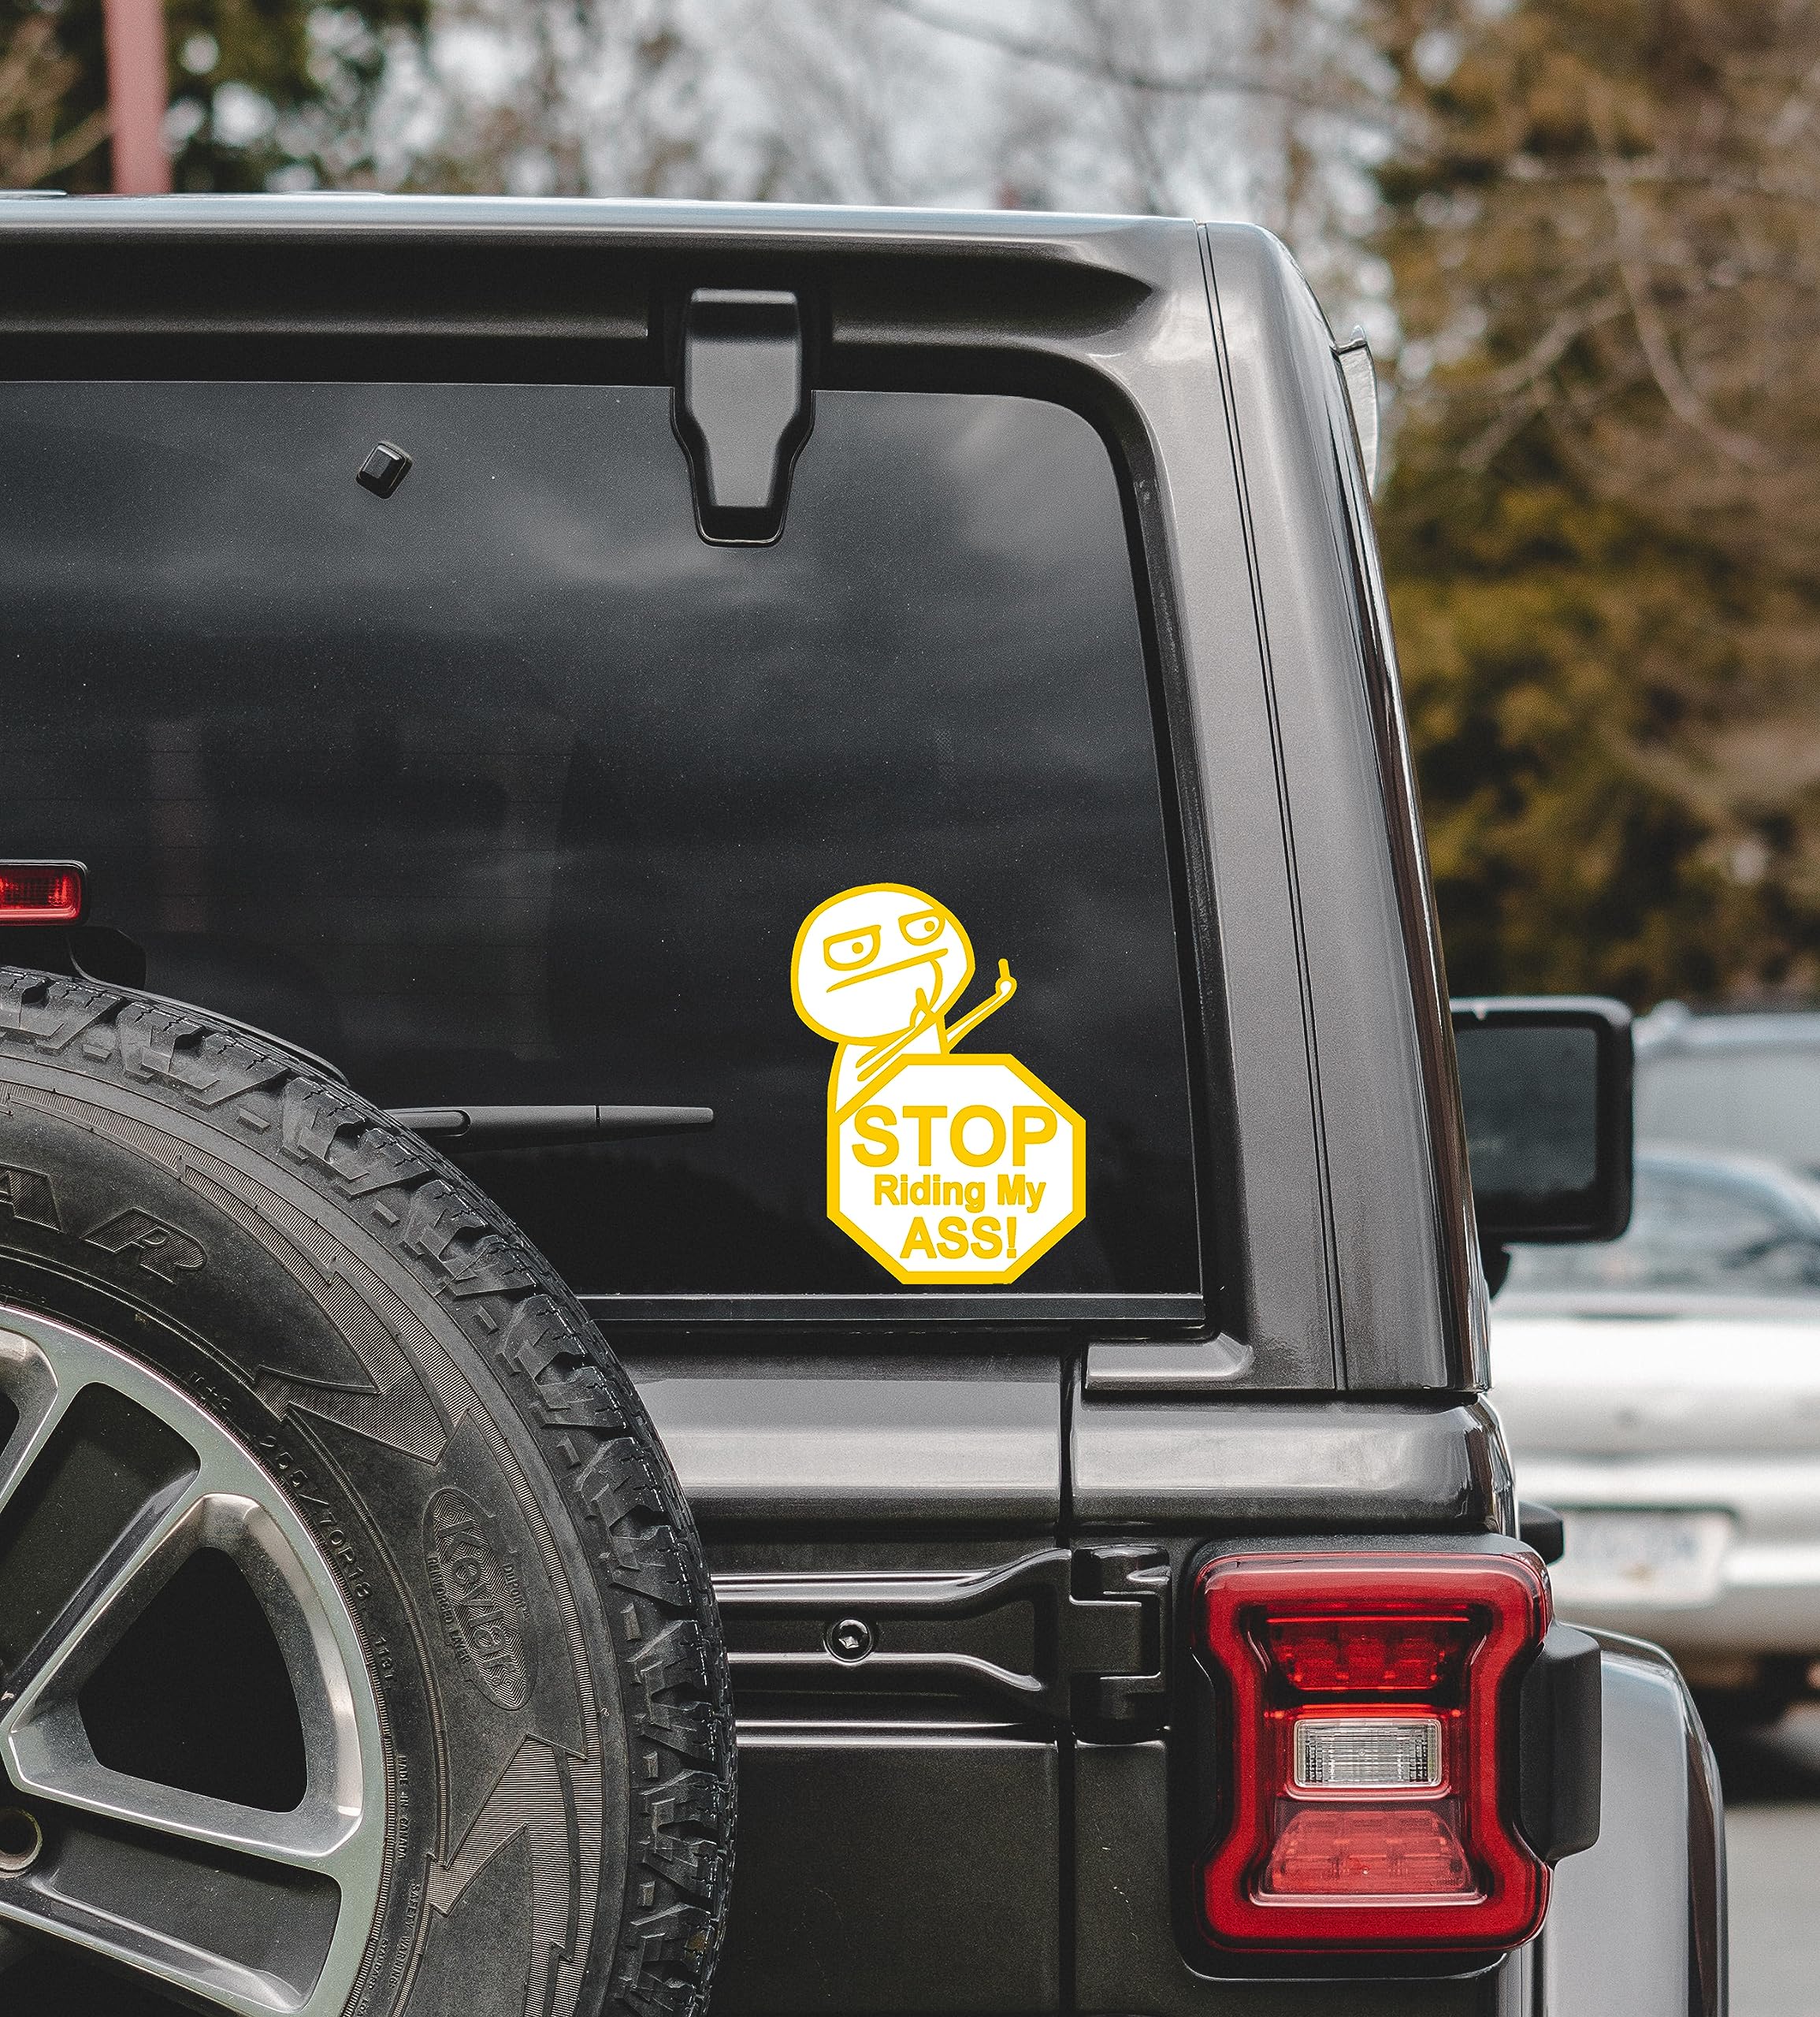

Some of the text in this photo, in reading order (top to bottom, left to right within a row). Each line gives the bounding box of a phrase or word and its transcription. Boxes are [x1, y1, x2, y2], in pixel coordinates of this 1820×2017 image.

[852, 1105, 1058, 1168] STOP
[874, 1173, 1047, 1214] Riding My
[899, 1216, 1017, 1260] ASS!
